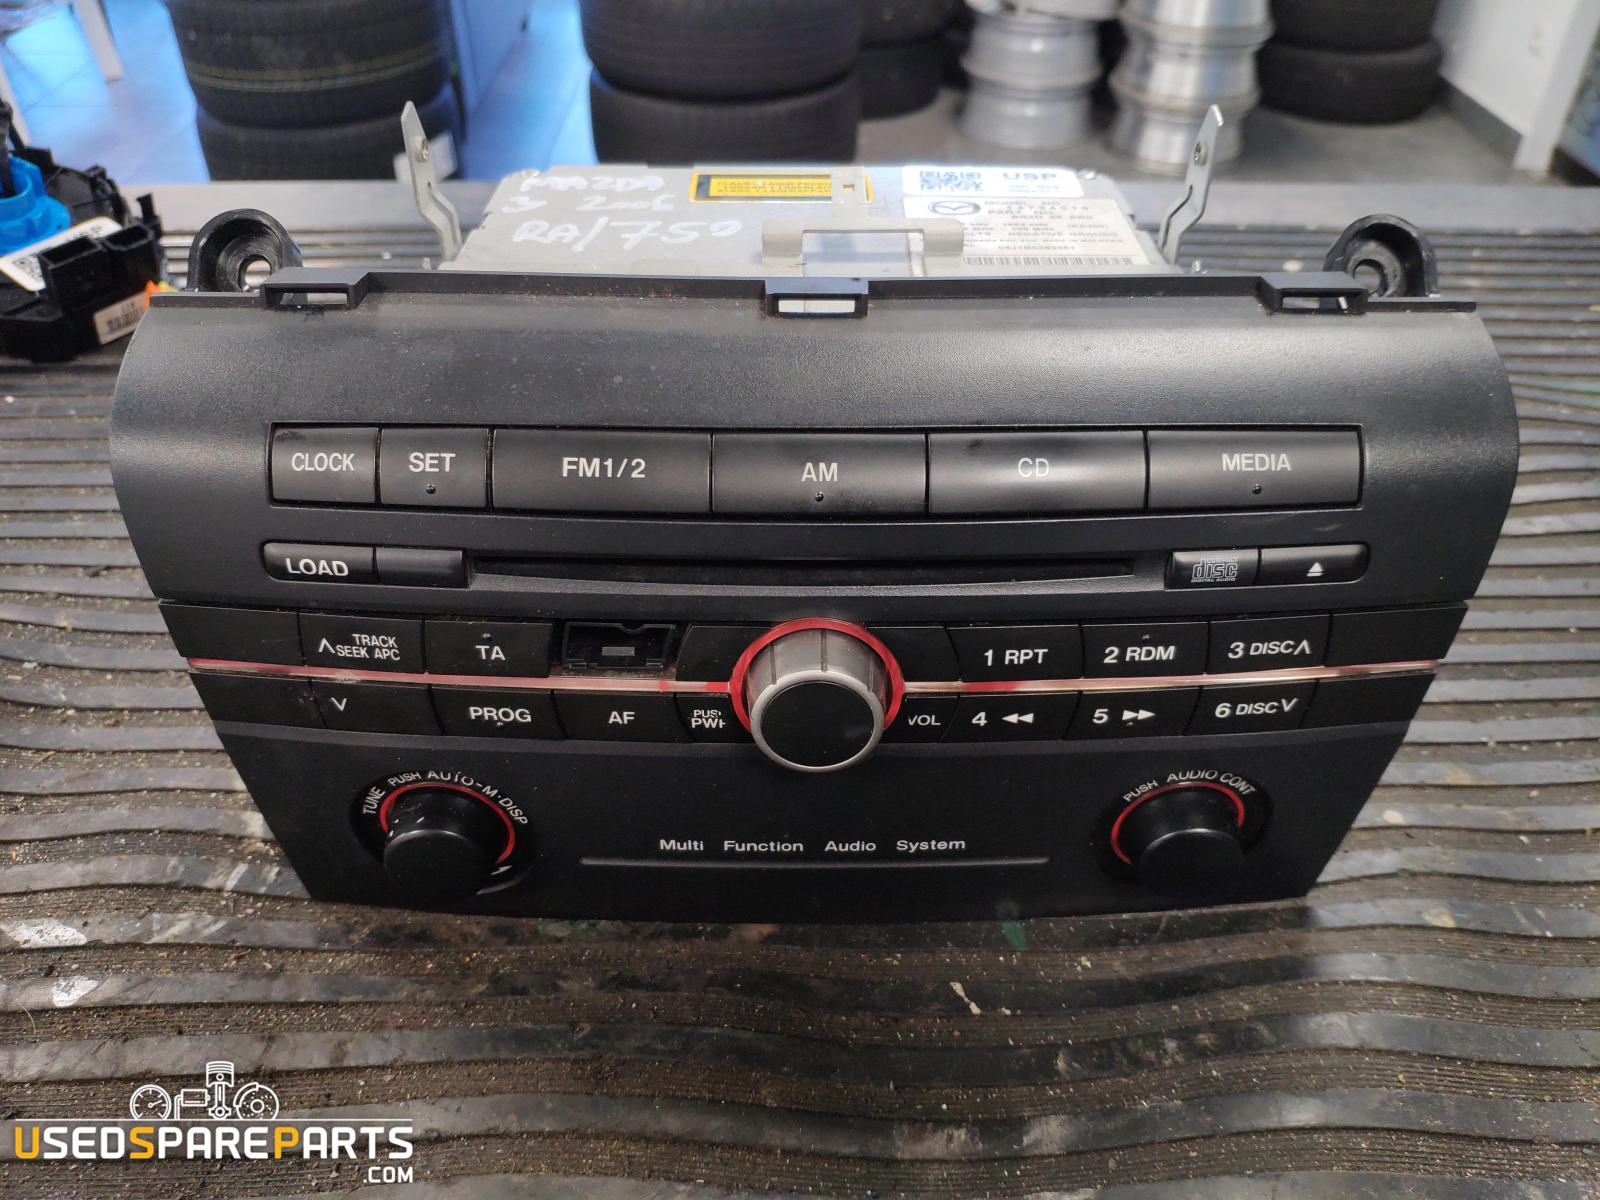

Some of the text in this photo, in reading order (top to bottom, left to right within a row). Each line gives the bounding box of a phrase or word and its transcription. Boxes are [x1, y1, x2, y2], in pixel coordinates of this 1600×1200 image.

[1003, 172, 1058, 180] USP
[575, 193, 676, 212] 2006
[292, 453, 354, 471] CLOCK
[409, 452, 455, 472] SET
[563, 457, 645, 478] FM1/2
[1018, 458, 1050, 477] CD
[1222, 454, 1291, 471] MEDIA
[801, 463, 837, 482] AM
[286, 557, 349, 577] LOAD
[1192, 558, 1237, 578] disc
[352, 633, 398, 648] TRACK
[336, 645, 401, 661] SEEK APC
[476, 646, 505, 660] TA
[985, 649, 1048, 666] 1 RPT
[1104, 646, 1175, 663] 2 RDM
[1228, 642, 1244, 658] 3
[469, 706, 532, 723] PROG
[608, 711, 635, 725] AF
[972, 712, 987, 726] 4
[1093, 709, 1108, 723] 5
[1215, 703, 1231, 718] 6
[907, 714, 941, 726] VOL
[363, 787, 385, 813] TUNE
[387, 771, 422, 787] PUSH
[1122, 770, 1256, 802] PUSH AUDIO CONT
[660, 840, 965, 852] Multi Function Audio System
